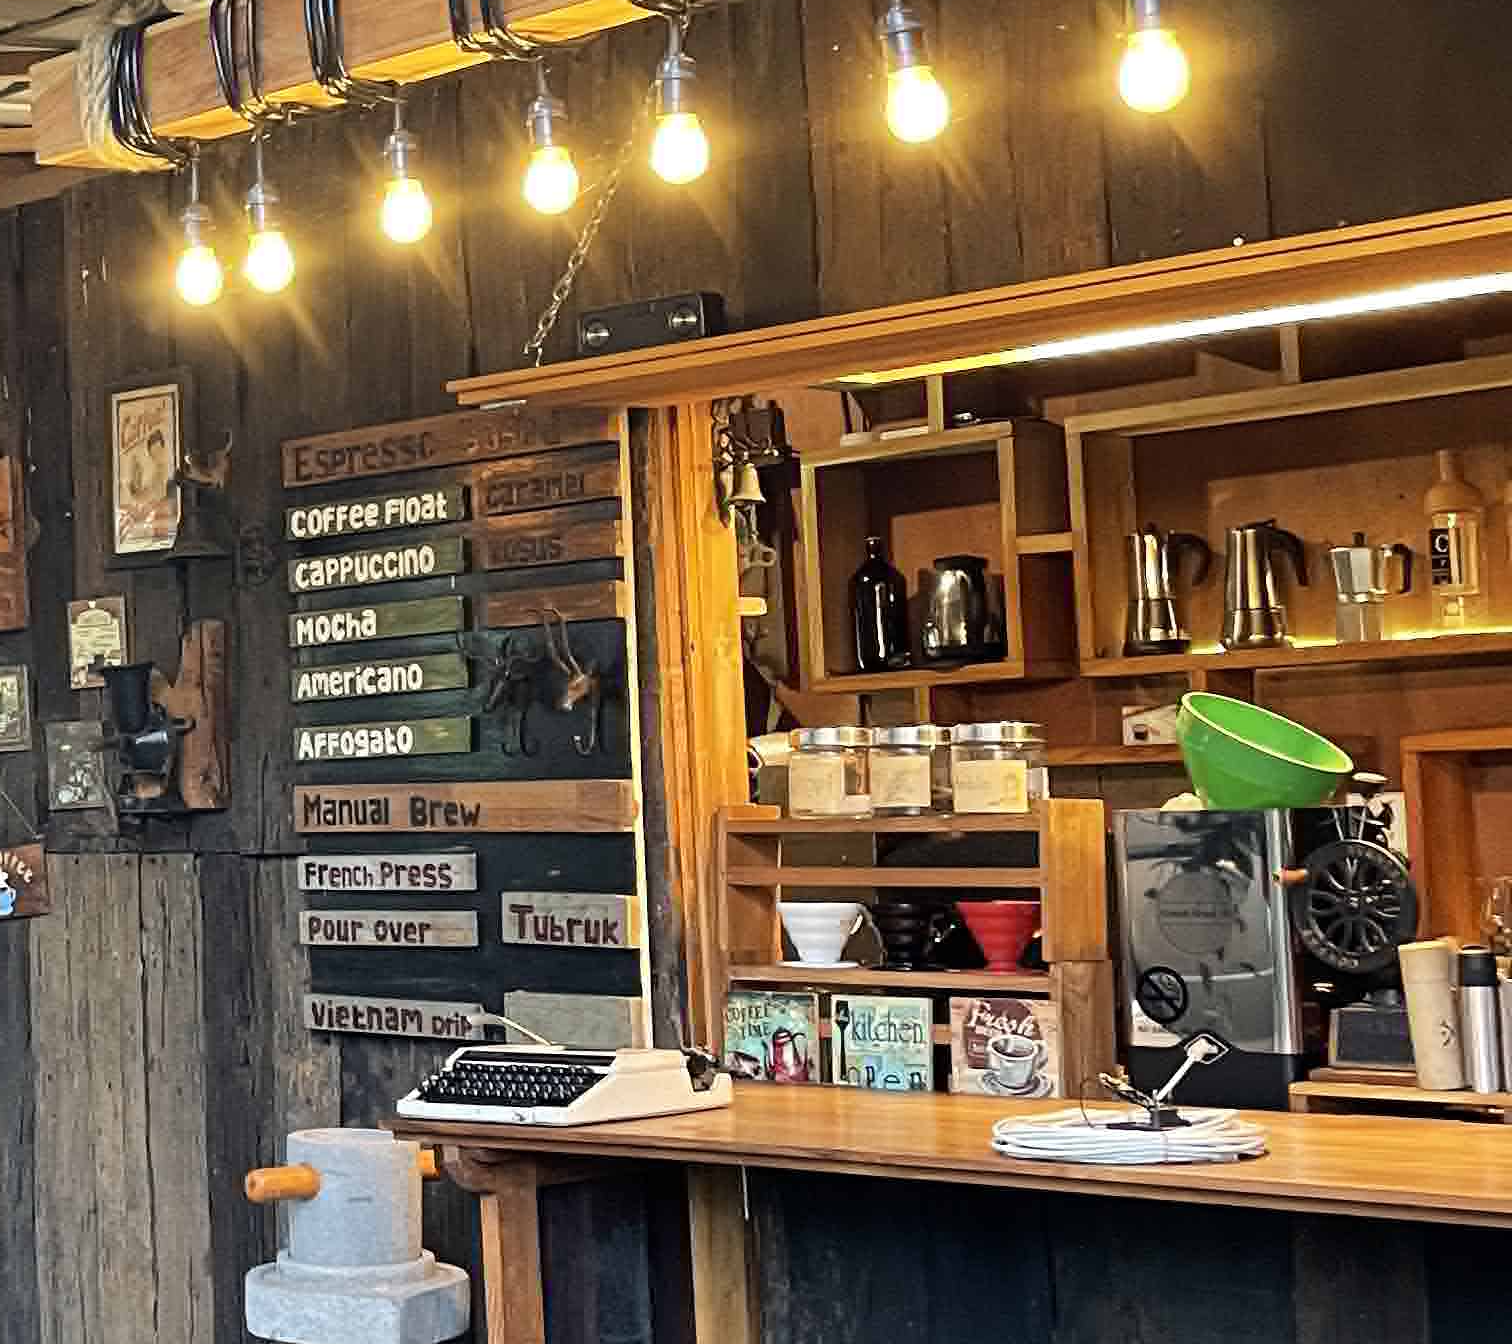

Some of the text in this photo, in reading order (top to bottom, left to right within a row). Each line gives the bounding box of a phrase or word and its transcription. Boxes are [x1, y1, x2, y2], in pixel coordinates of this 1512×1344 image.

[297, 664, 424, 700] Americano
[303, 793, 481, 827] Manual Brew
[304, 862, 453, 889] French Press
[308, 917, 363, 943] Pour
[509, 903, 619, 945] Tubruk
[850, 1008, 924, 1044] kitchen
